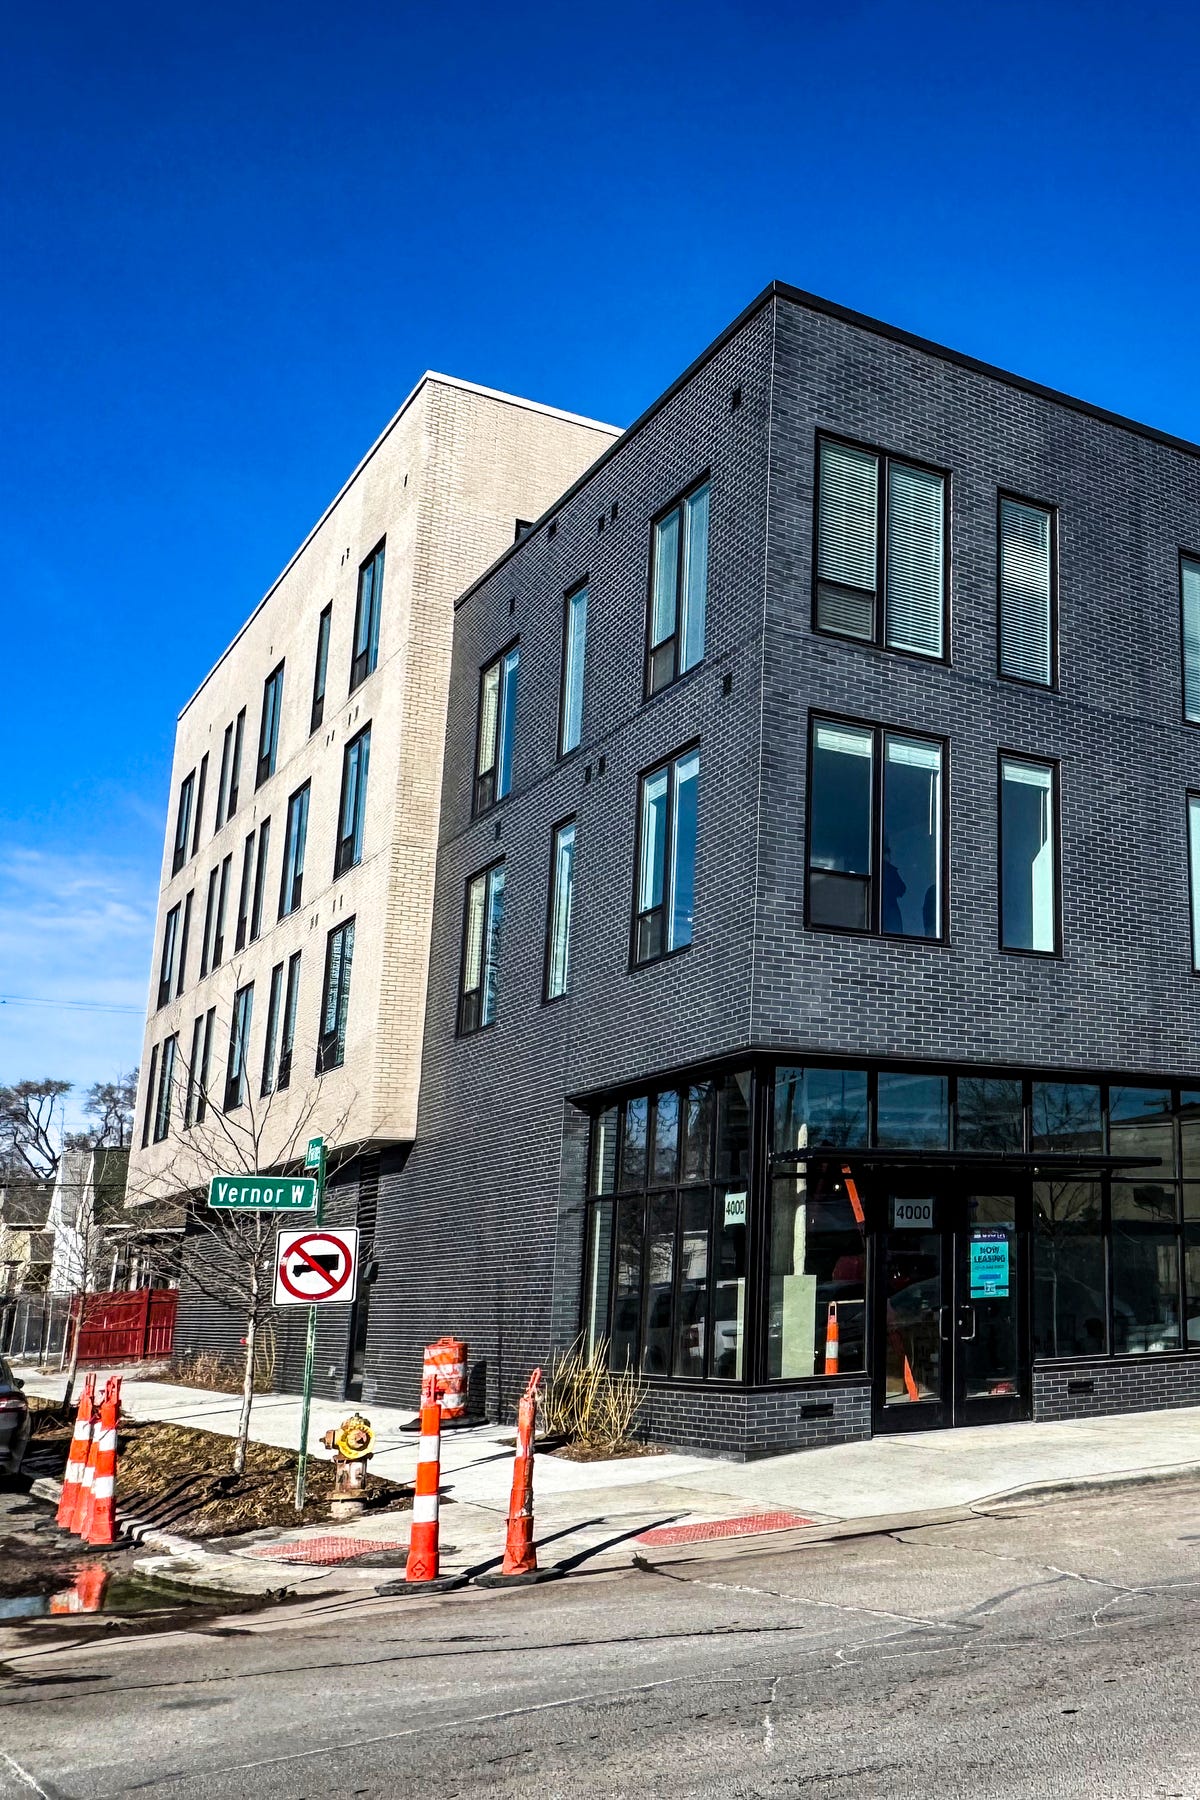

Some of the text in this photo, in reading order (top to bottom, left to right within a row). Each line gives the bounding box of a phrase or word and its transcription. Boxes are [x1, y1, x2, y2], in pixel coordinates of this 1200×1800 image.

[218, 1183, 305, 1204] Vernor W
[896, 1205, 931, 1220] 4000
[979, 1246, 1000, 1255] NOW
[973, 1254, 1006, 1264] LEASING
